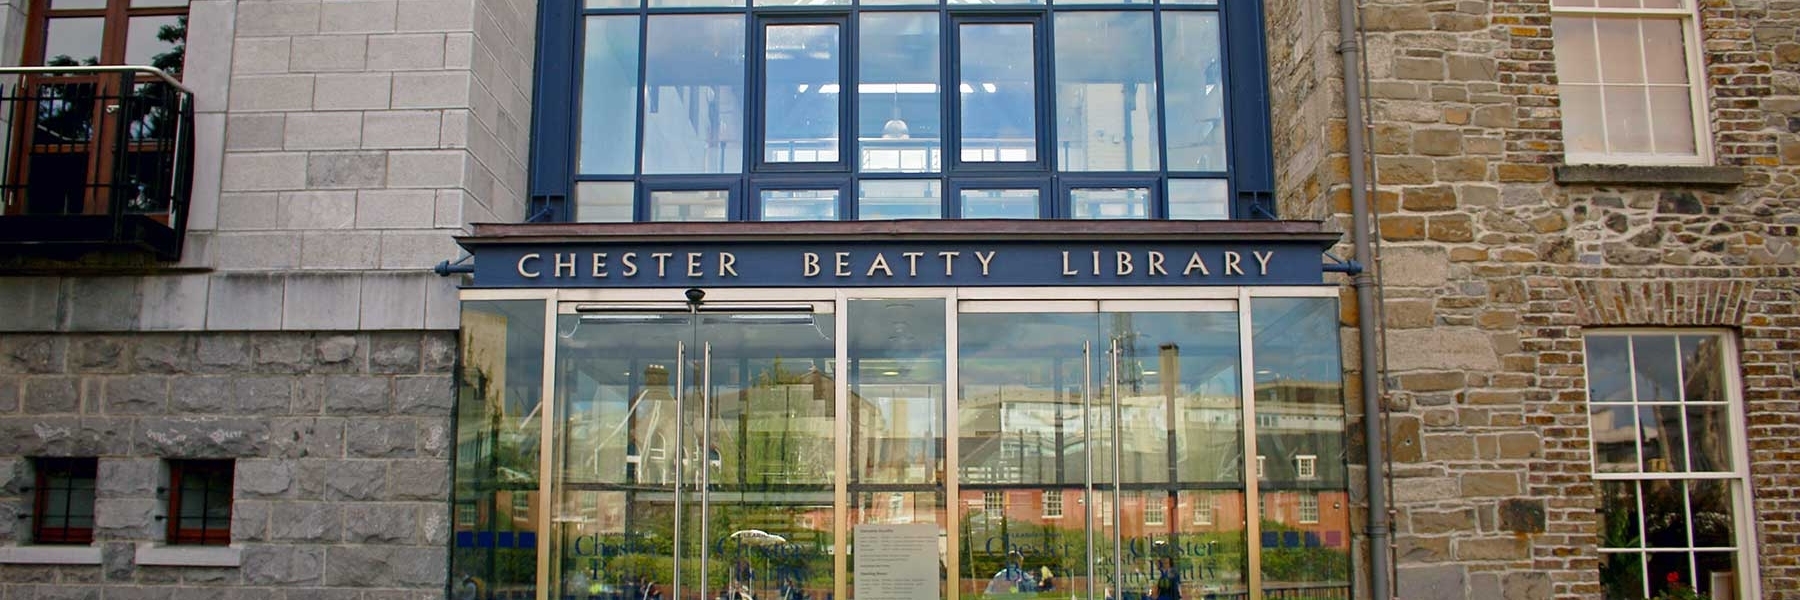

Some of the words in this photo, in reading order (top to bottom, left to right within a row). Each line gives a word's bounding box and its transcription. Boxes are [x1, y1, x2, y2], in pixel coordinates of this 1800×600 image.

[518, 252, 739, 279] CHESTER
[803, 250, 996, 278] BEATTY
[1062, 250, 1275, 277] LIBRARY
